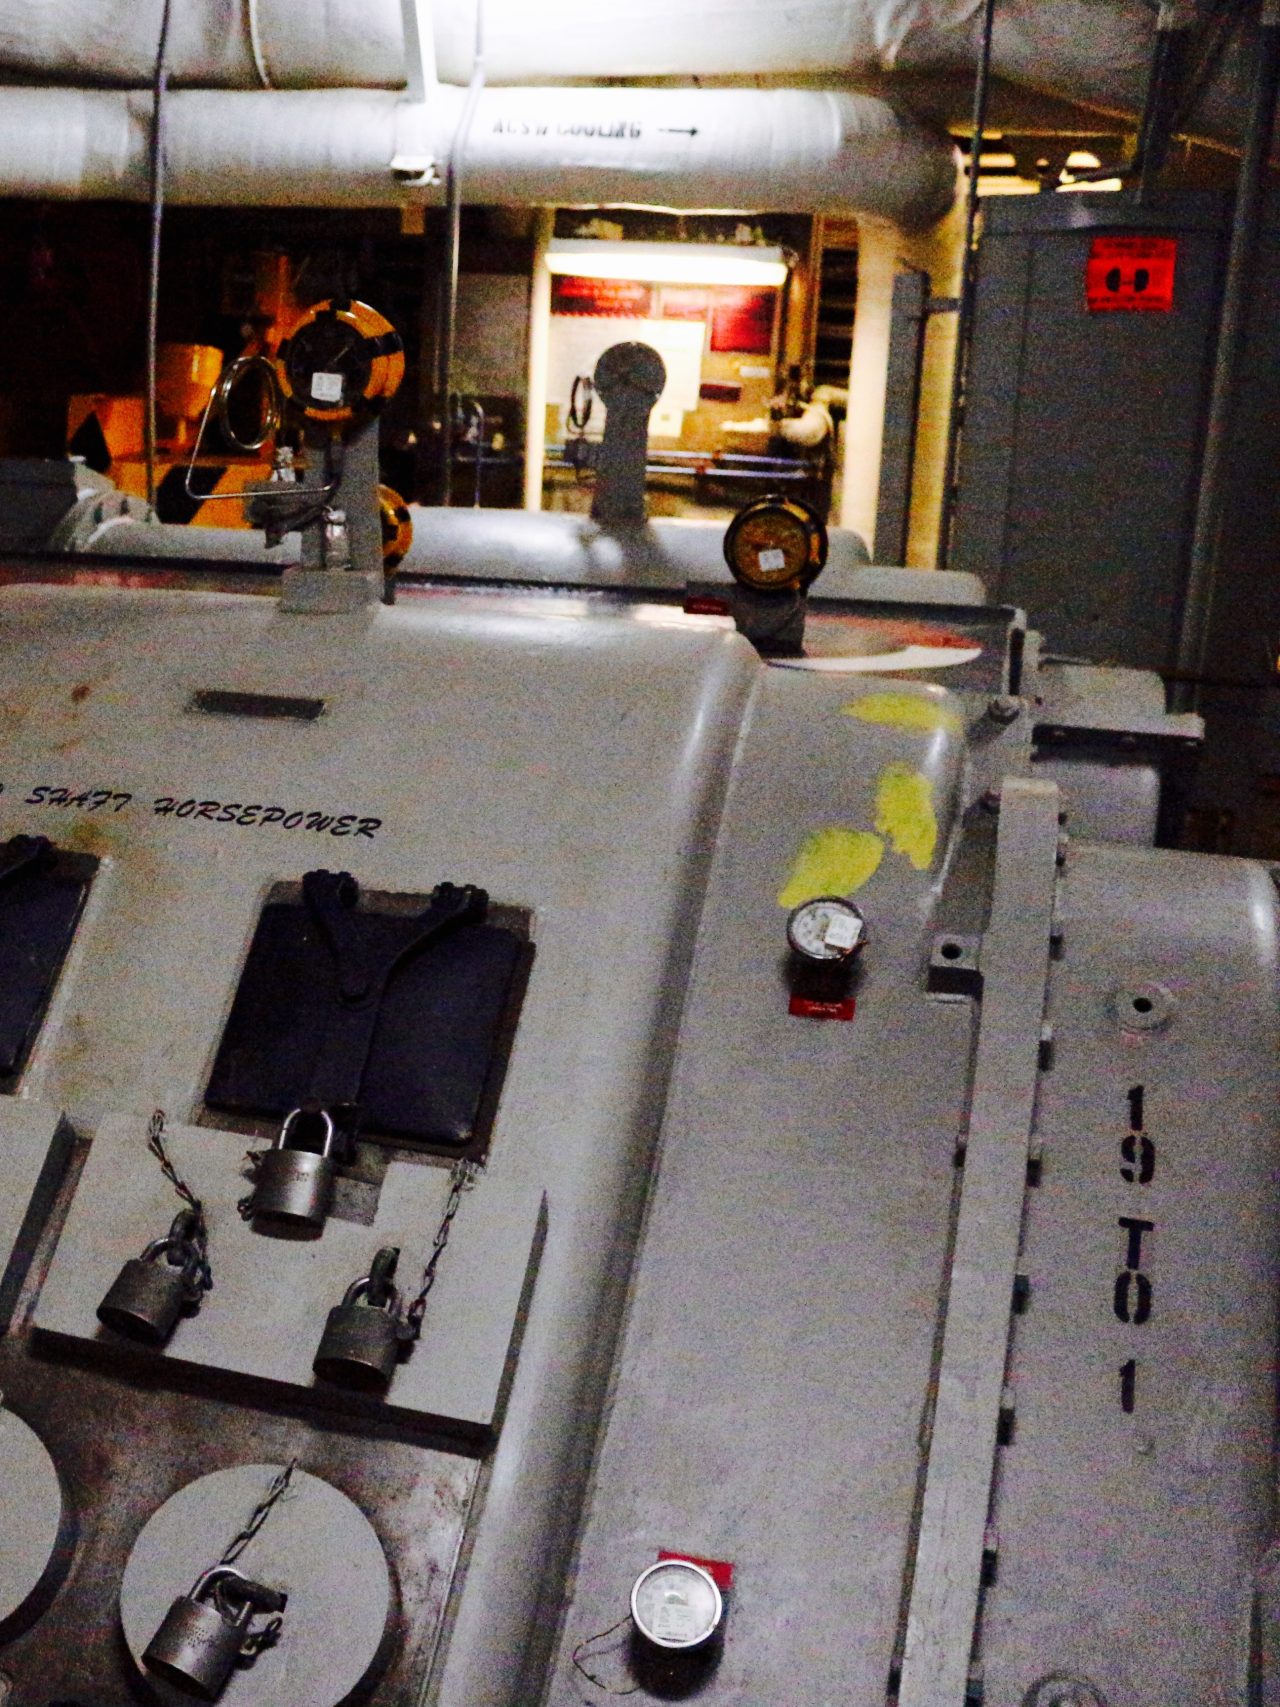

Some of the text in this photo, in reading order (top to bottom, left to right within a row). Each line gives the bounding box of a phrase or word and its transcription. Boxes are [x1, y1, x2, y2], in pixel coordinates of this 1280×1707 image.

[24, 786, 133, 813] SHAFT
[154, 798, 383, 839] HORSEPOWER
[1120, 1084, 1156, 1184] 19
